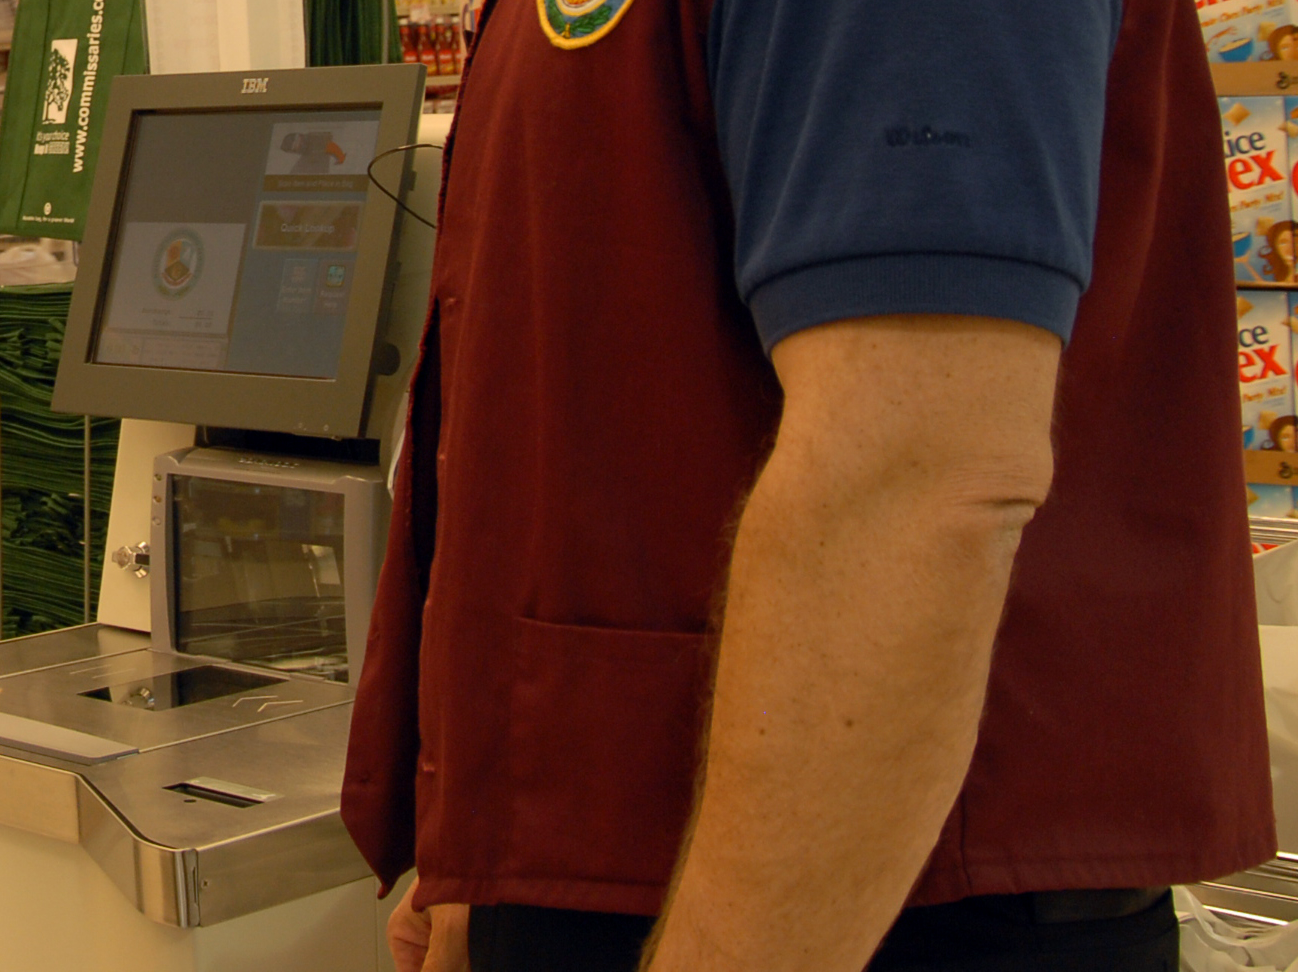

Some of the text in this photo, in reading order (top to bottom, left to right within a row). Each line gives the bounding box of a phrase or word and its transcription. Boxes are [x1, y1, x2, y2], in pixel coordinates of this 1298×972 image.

[240, 78, 269, 94] IBM
[1227, 149, 1287, 190] ex
[280, 222, 302, 233] Quick
[1238, 324, 1269, 348] ce
[1238, 342, 1289, 383] ex
